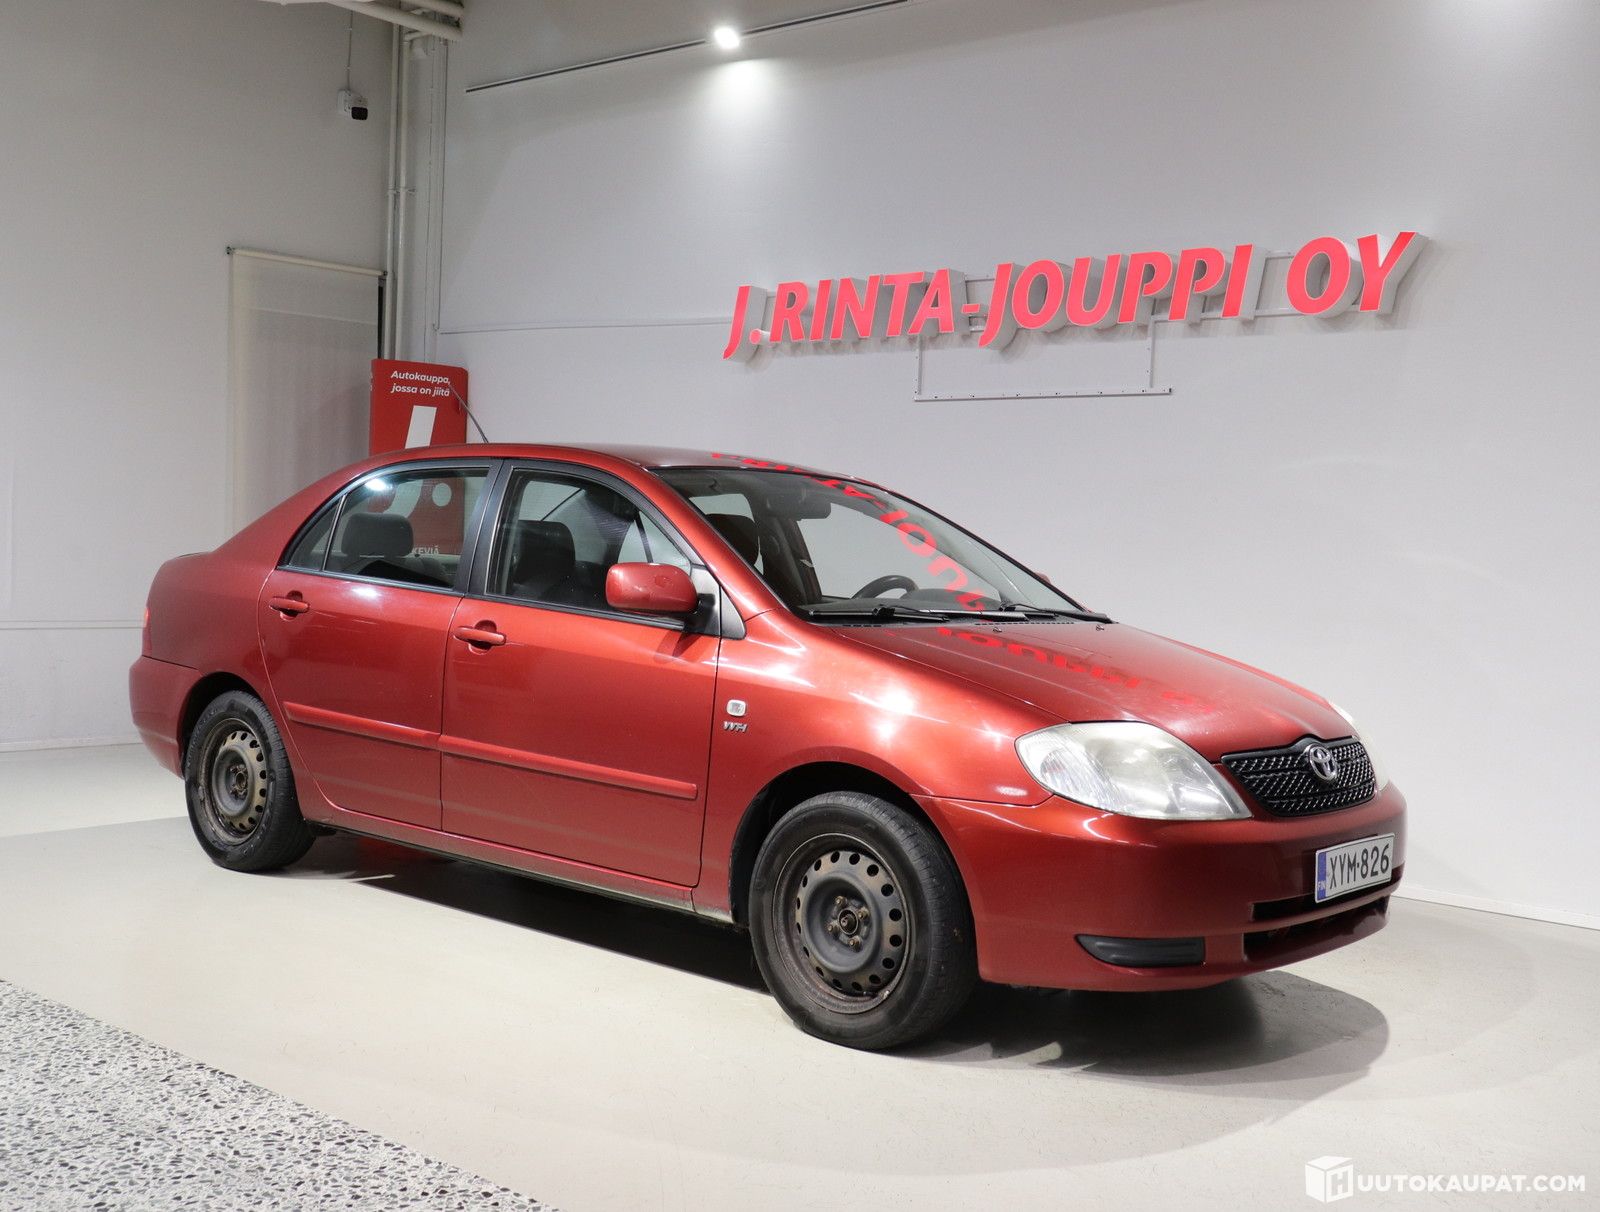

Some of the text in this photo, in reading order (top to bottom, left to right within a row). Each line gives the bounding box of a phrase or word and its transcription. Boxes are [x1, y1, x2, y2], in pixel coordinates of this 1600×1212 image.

[1286, 231, 1415, 315] OY
[391, 370, 451, 385] Autokauppa,
[390, 383, 417, 393] jossa
[432, 386, 450, 397] jiitä
